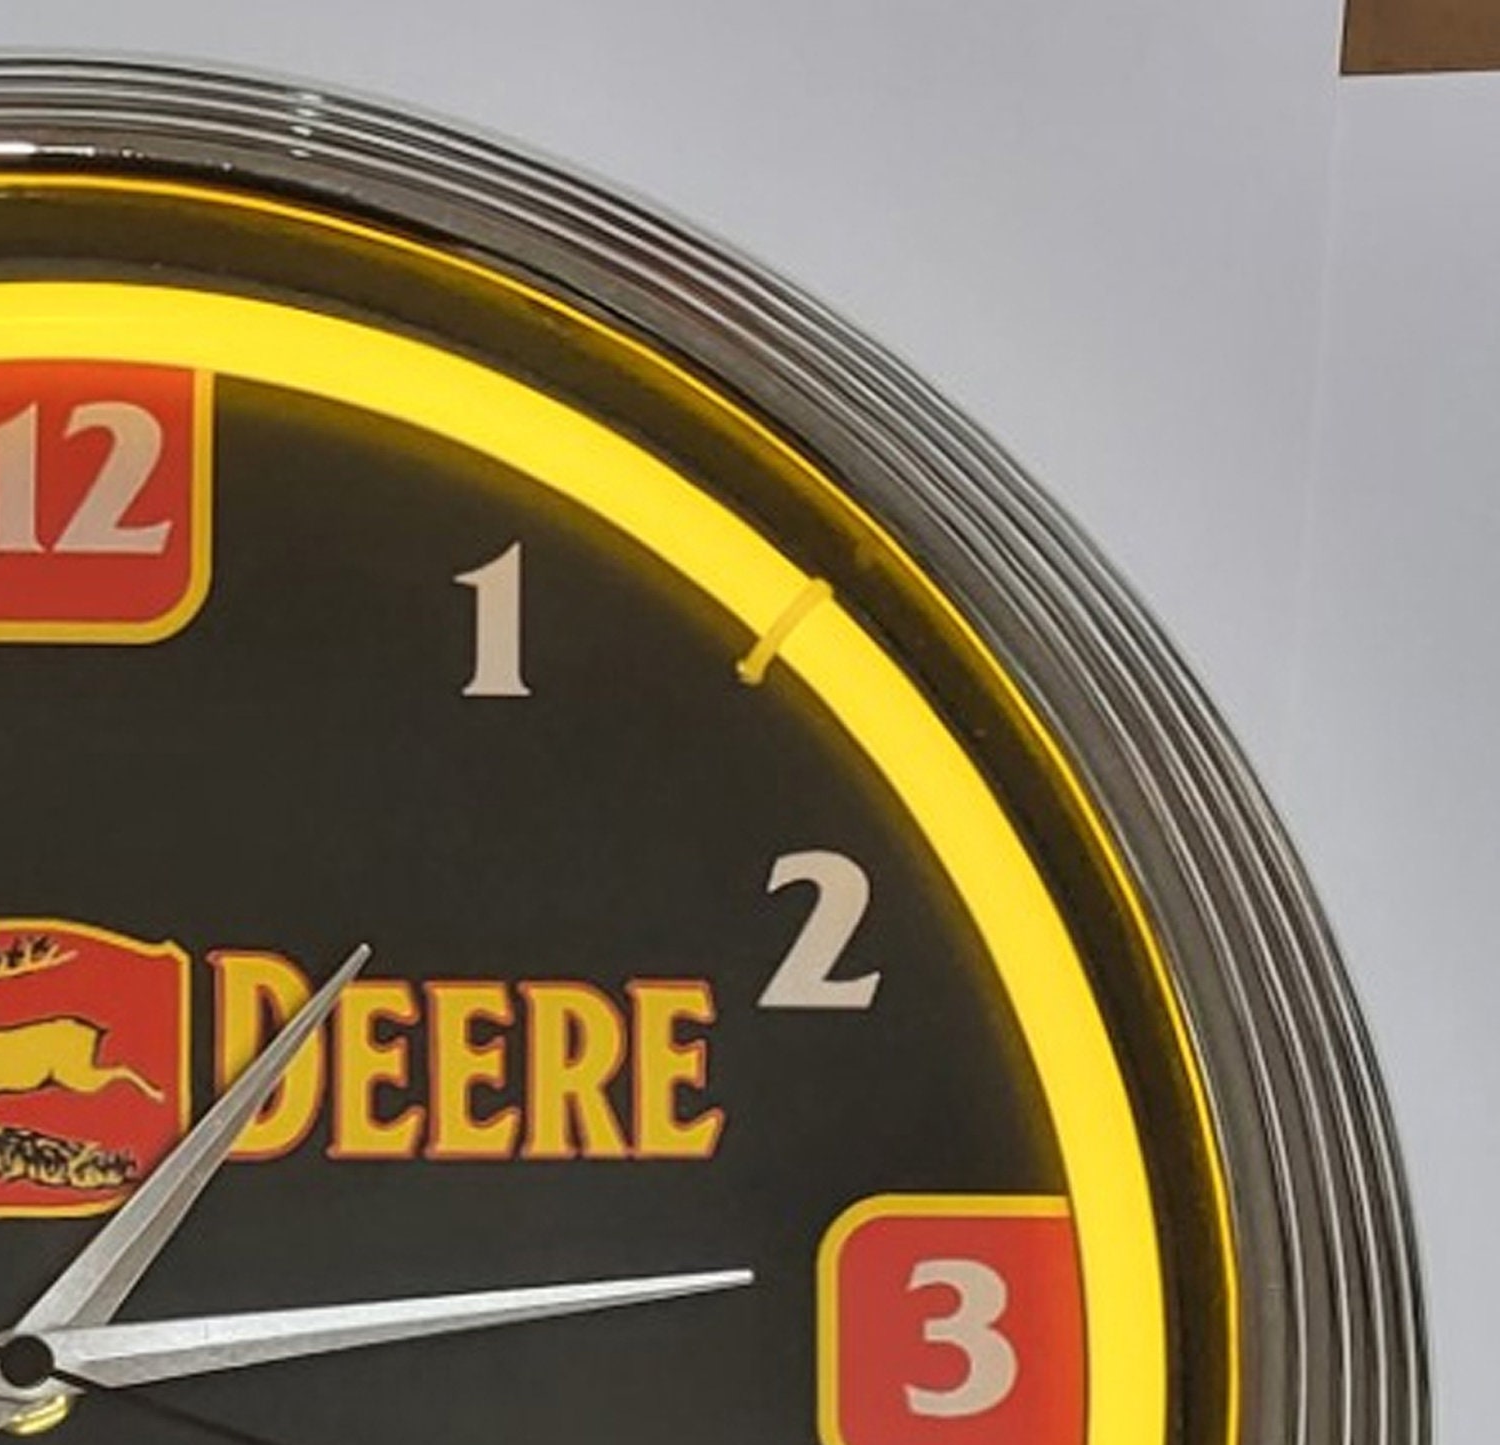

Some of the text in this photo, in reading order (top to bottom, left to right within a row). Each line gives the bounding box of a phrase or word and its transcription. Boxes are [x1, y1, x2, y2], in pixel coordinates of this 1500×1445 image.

[454, 542, 532, 698] 1
[757, 850, 881, 1009] 2
[206, 949, 723, 1160] DEERE
[904, 1258, 1017, 1418] 3
